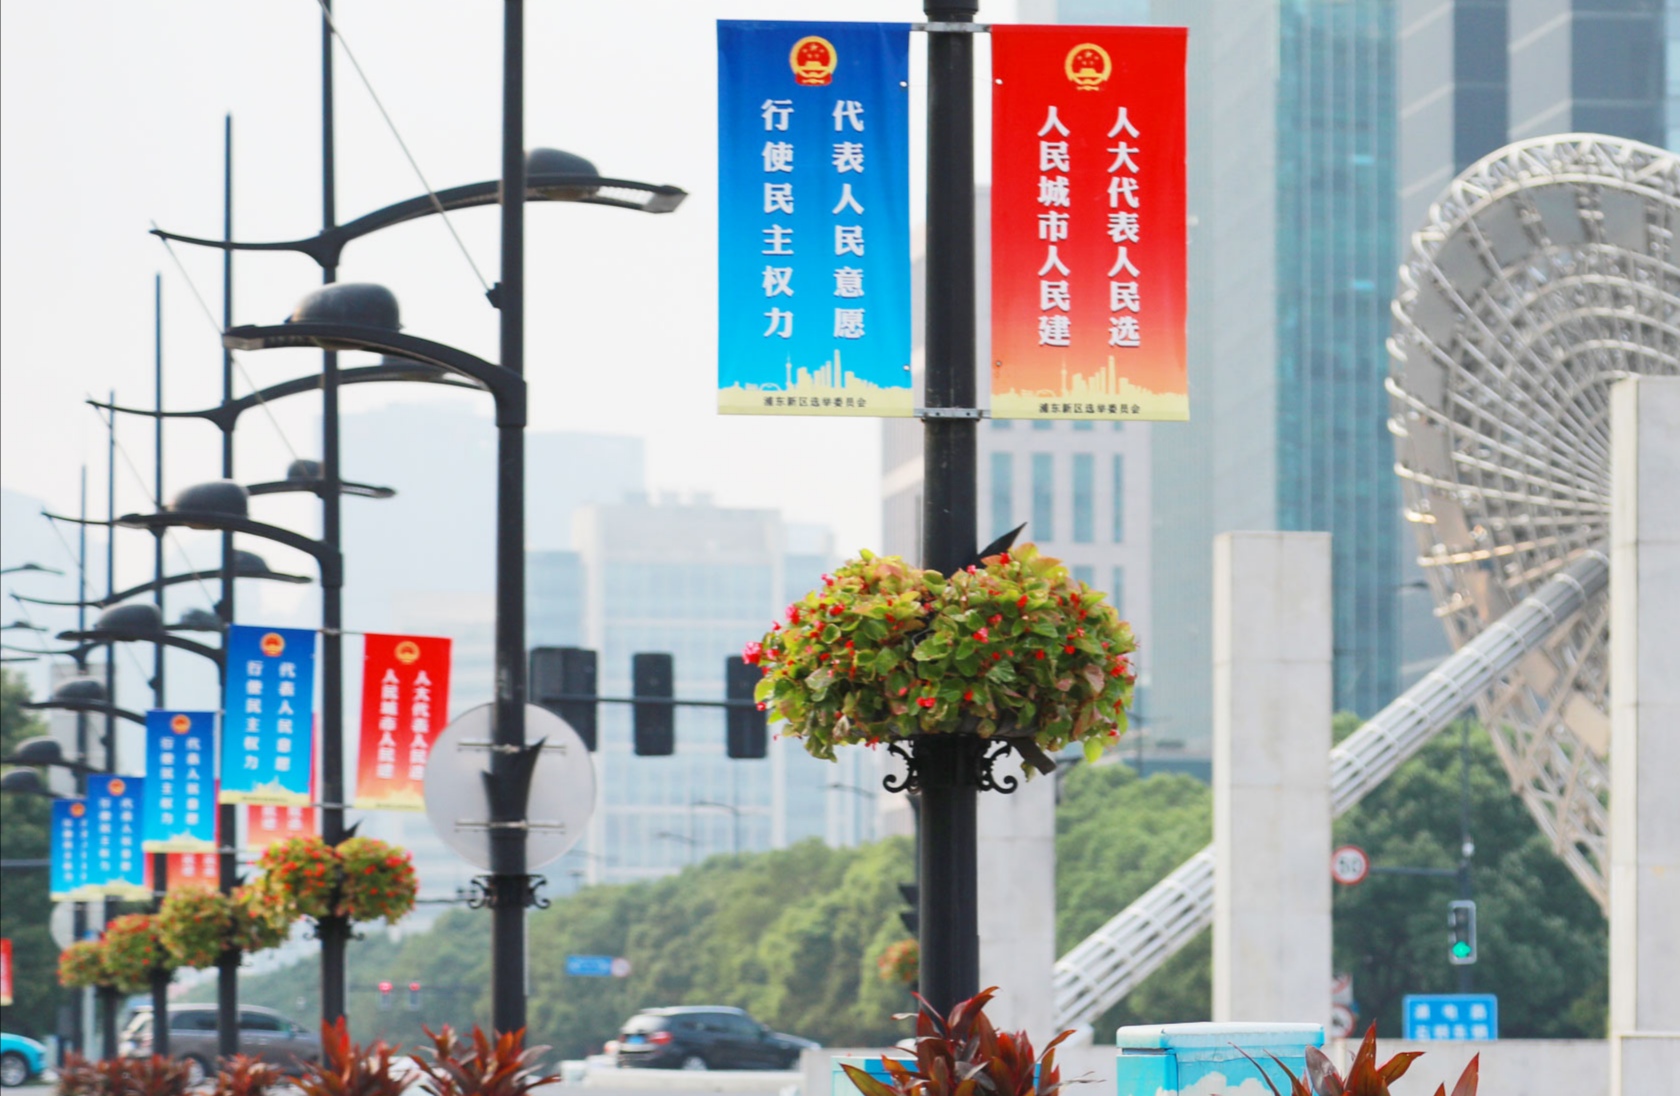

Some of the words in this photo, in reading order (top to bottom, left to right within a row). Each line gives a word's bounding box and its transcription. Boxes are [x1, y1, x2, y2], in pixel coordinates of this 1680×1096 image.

[761, 99, 795, 340] 行使民主权力
[832, 99, 866, 340] 代表人民意愿
[1037, 105, 1071, 348] 人民城市人民建
[1107, 106, 1141, 349] 人大代表人民选
